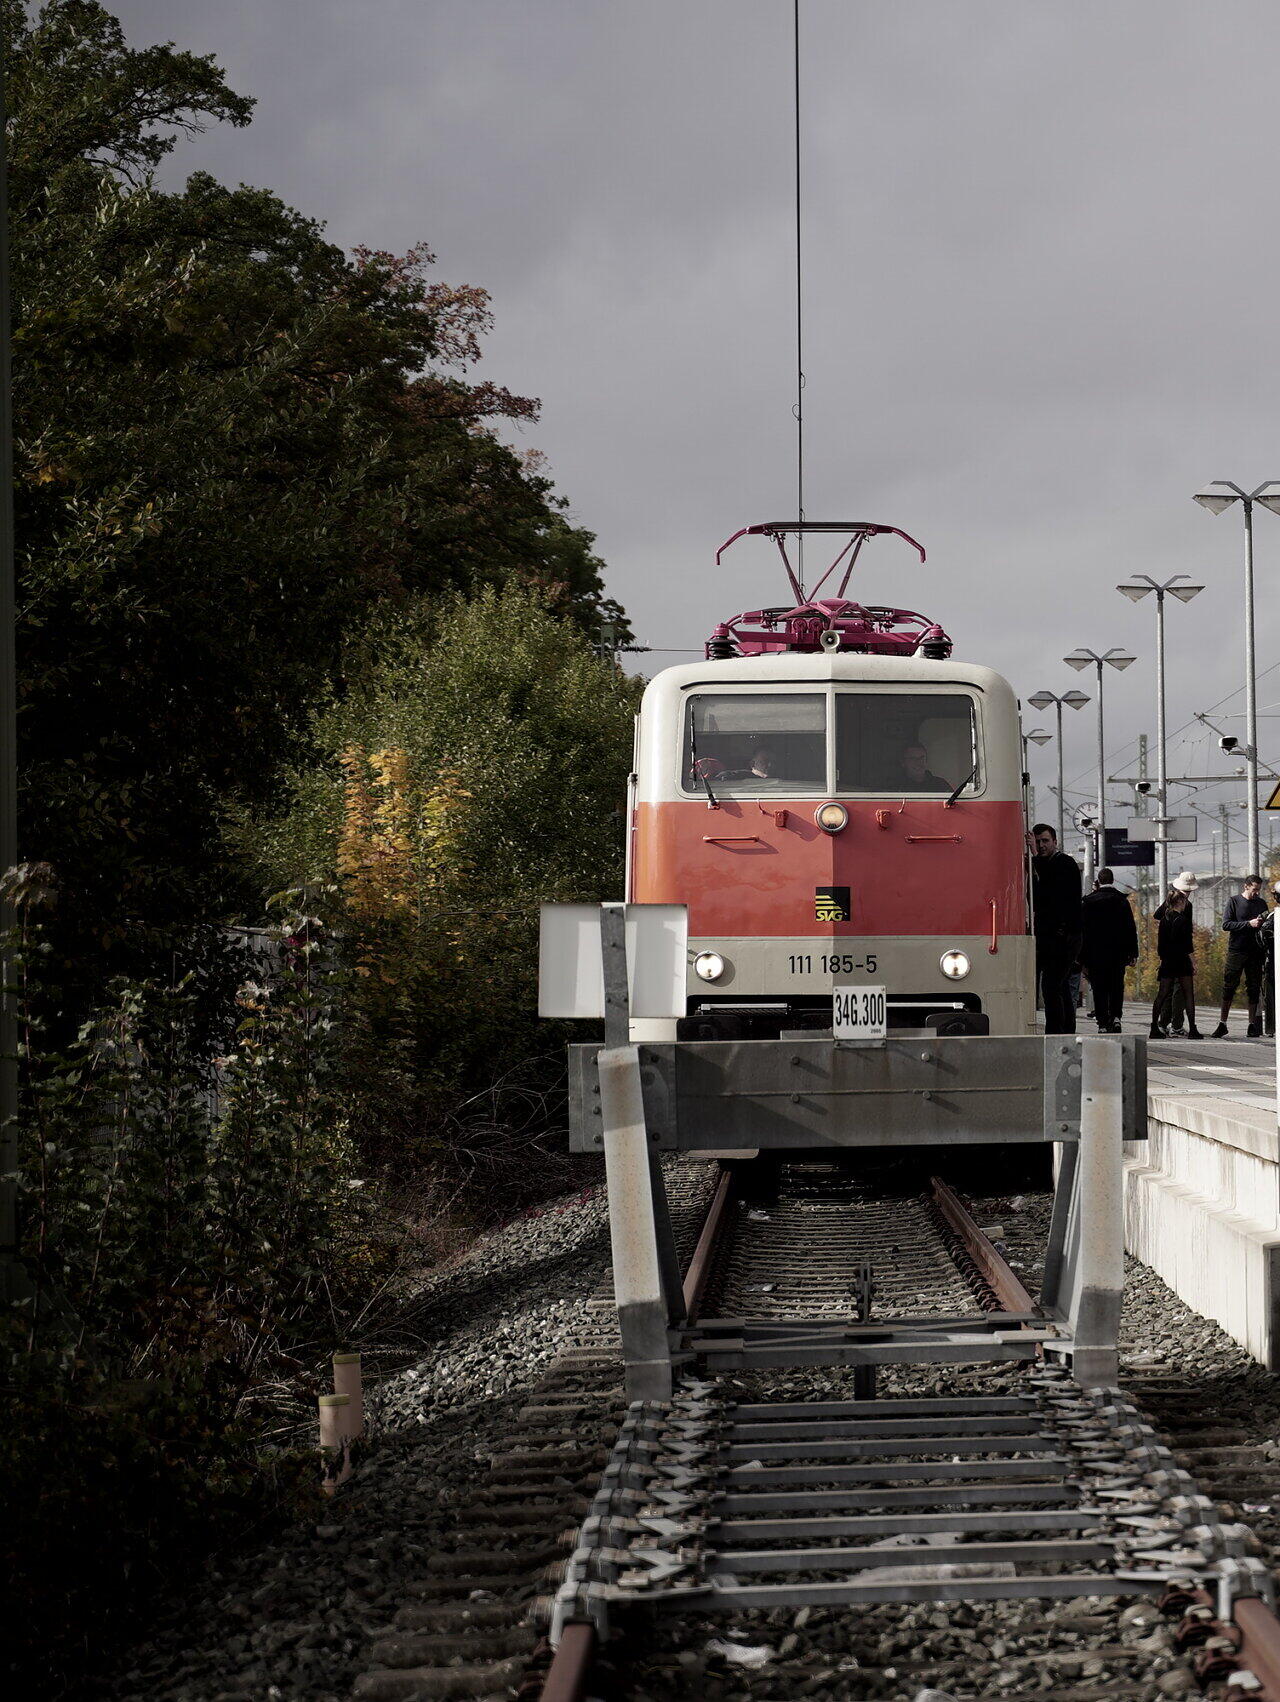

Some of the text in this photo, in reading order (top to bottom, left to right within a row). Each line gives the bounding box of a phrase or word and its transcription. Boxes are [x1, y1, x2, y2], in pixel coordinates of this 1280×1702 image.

[815, 910, 843, 922] SVG
[788, 954, 878, 974] 111 185-5
[835, 993, 884, 1027] 34G.300
